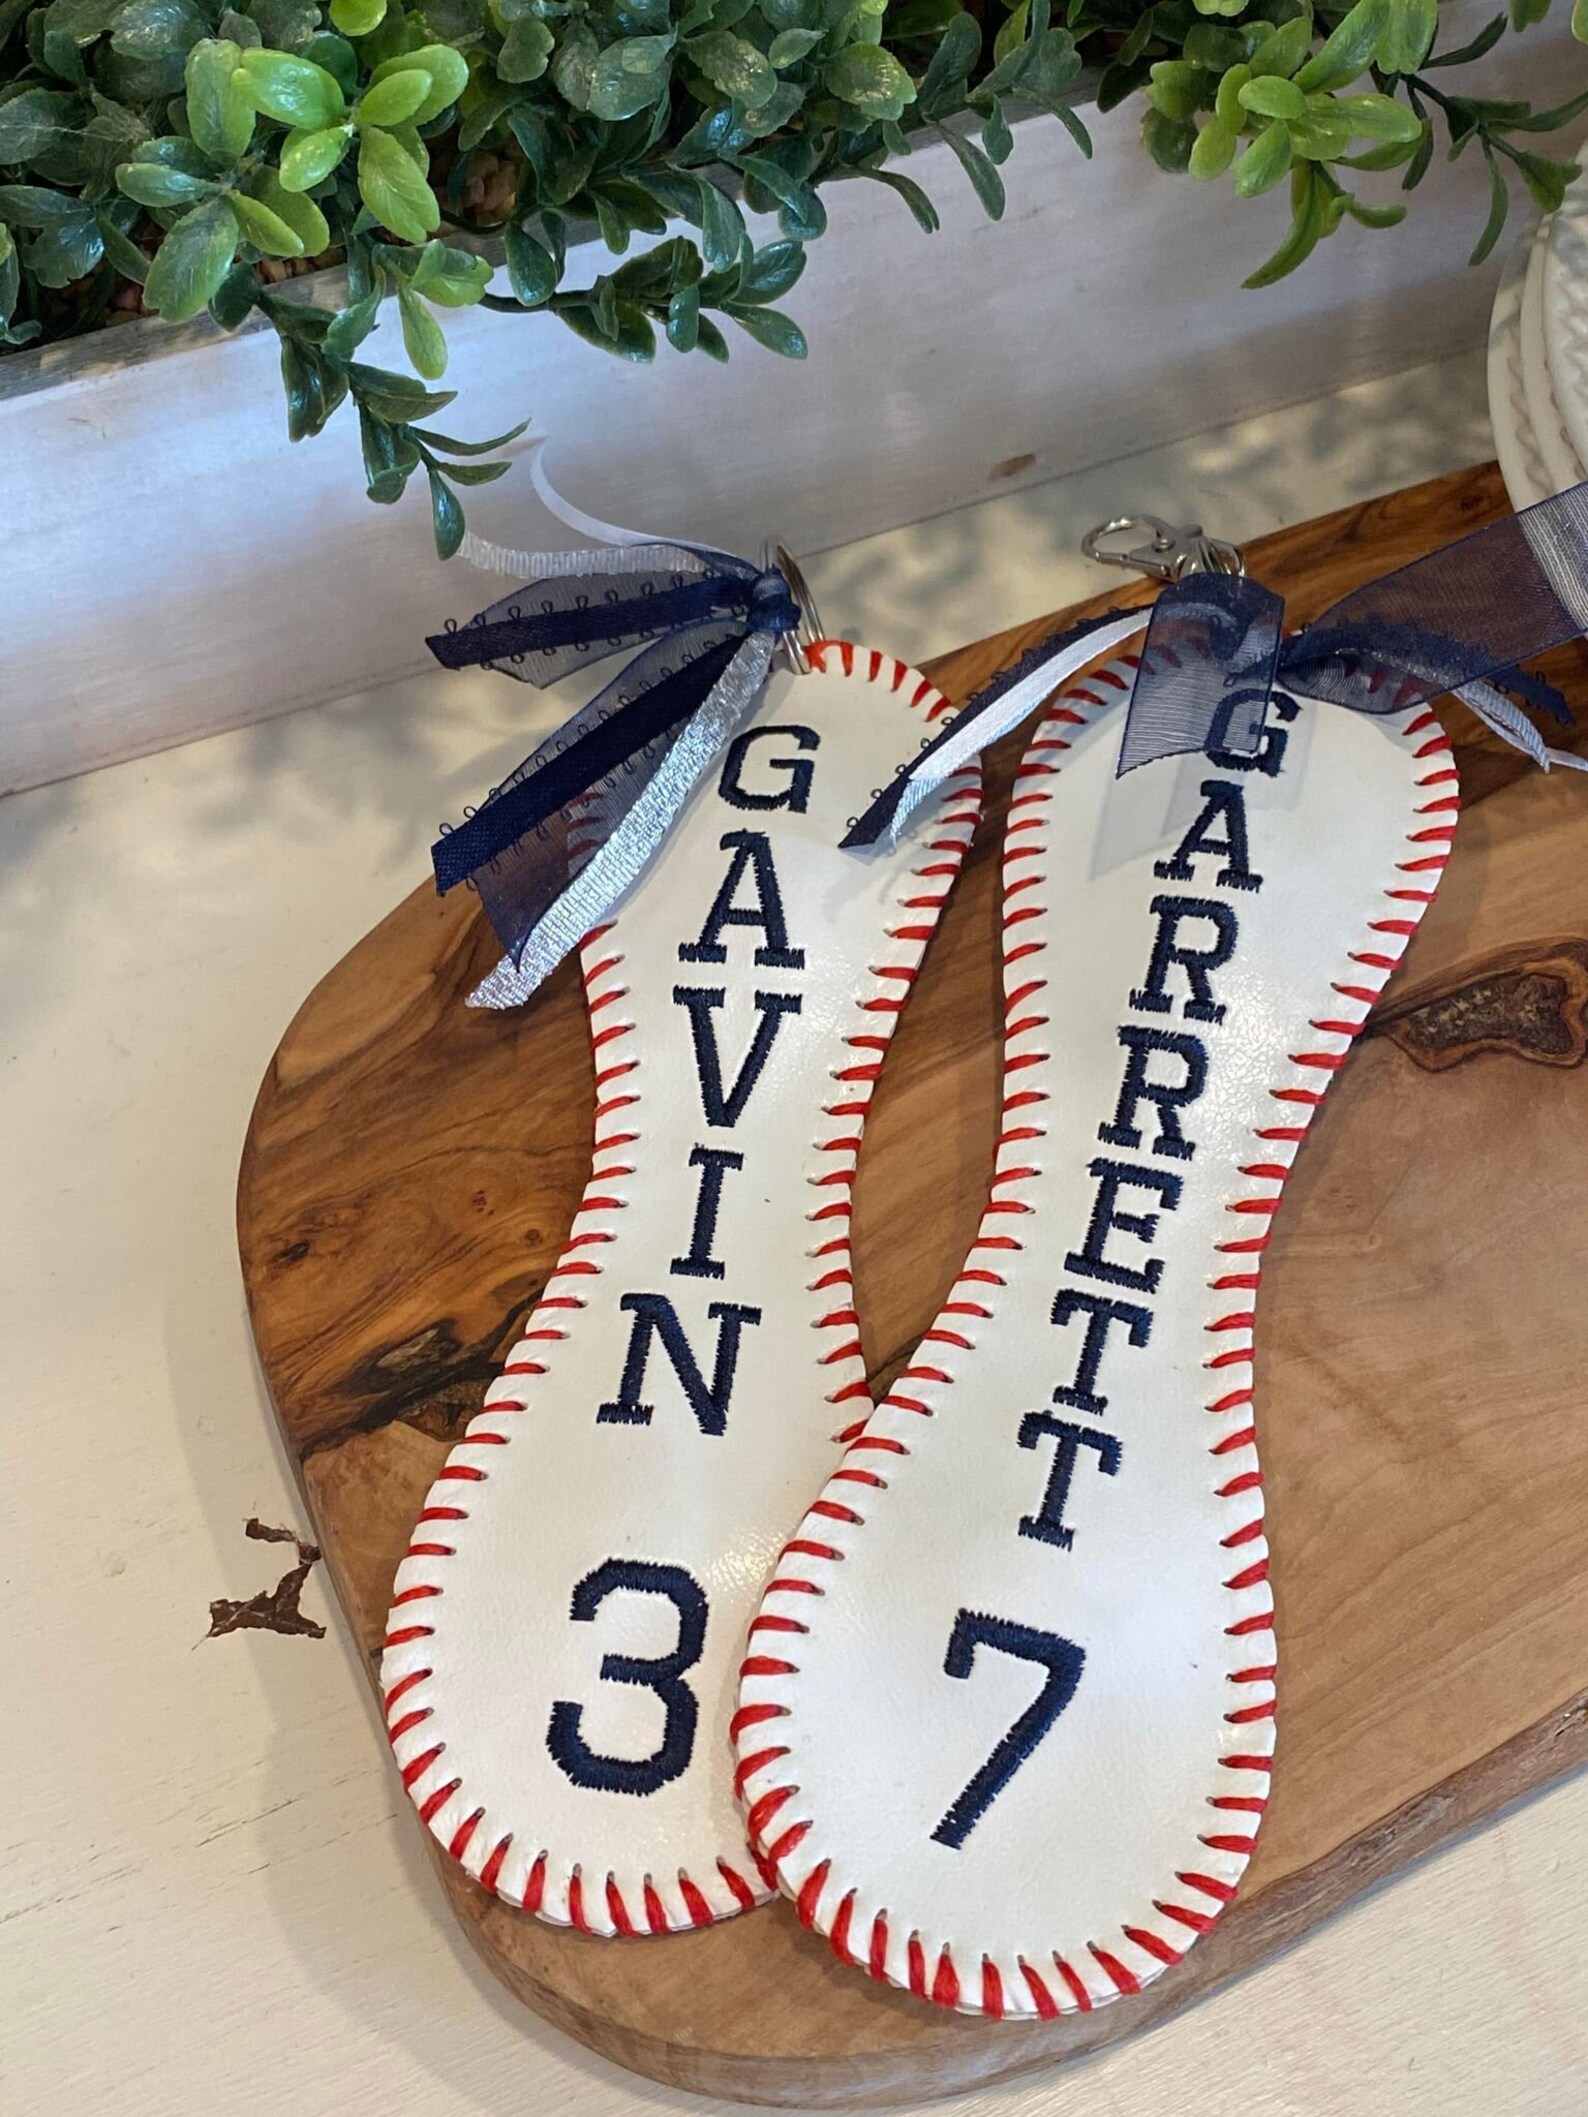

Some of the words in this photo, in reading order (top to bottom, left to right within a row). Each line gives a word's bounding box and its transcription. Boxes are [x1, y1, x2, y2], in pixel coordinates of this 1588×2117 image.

[597, 724, 821, 1436] GAVIN
[1017, 687, 1302, 1551] GARRETT
[545, 1558, 710, 1798] 3
[930, 1608, 1087, 1850] 7
